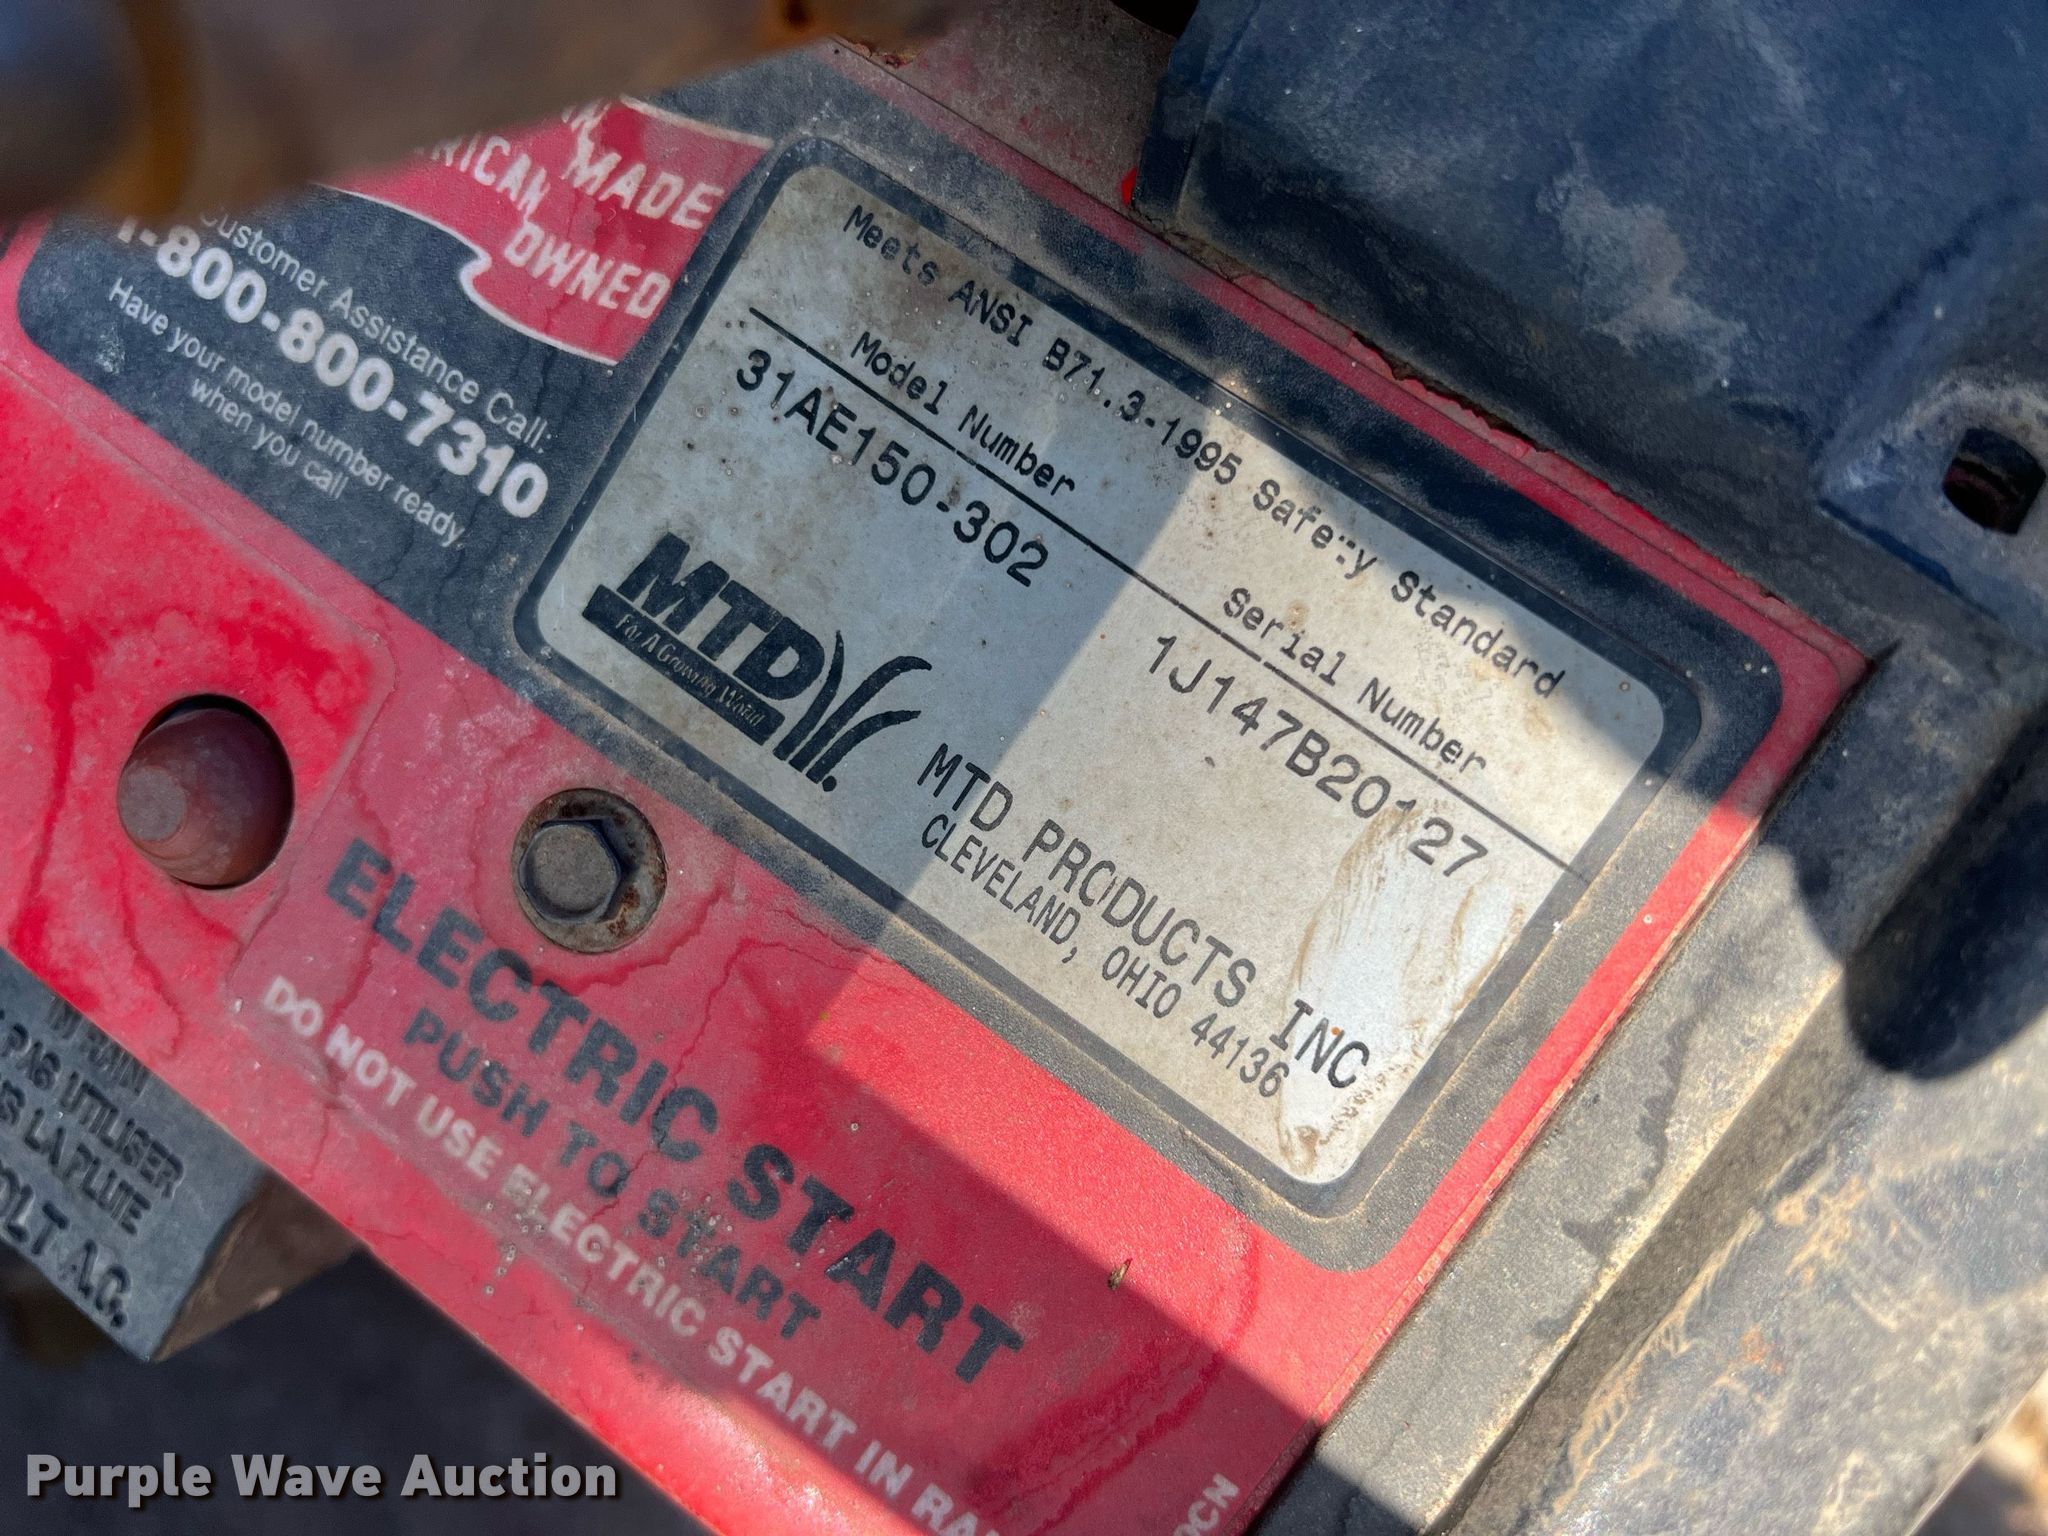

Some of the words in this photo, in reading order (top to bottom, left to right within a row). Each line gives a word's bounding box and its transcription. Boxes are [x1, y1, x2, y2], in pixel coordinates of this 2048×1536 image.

[504, 220, 671, 319] OWNED
[561, 148, 723, 230] MADE
[108, 277, 169, 336] Have
[166, 327, 225, 373] your
[225, 364, 300, 426] model
[300, 419, 393, 492] number
[393, 484, 465, 547] ready
[190, 378, 252, 433] when
[252, 423, 300, 468] you
[303, 460, 349, 500] call
[329, 287, 480, 404] Assistance
[486, 392, 552, 453] Call:
[736, 348, 1048, 588] 31AE150-302
[843, 205, 939, 286] Meets
[949, 280, 1033, 347] ANSI
[1042, 337, 1242, 485] B71.3-1995
[1390, 570, 1566, 699] Standard
[850, 332, 947, 415] Model
[958, 405, 1075, 496] Number
[615, 532, 826, 702] MTD
[641, 633, 662, 653] A
[1223, 587, 1349, 686] Serial
[1357, 677, 1488, 776] Number
[1147, 635, 1490, 879] 1J147B20127
[916, 743, 1014, 832] MTD
[1023, 818, 1256, 1008] PRODUCTS
[1269, 999, 1370, 1089] INC
[921, 815, 1081, 964] CLEVELAND,
[1101, 946, 1182, 1019] OHIO
[1191, 1013, 1290, 1098] 44136
[326, 838, 719, 1163] ELECTRIC
[726, 1143, 1025, 1384] START
[404, 1007, 549, 1140] PUSH
[559, 1119, 634, 1200] TO
[636, 1186, 822, 1341] START
[262, 975, 325, 1038] DO
[323, 1022, 416, 1109] NOT
[415, 1093, 502, 1182] USE
[506, 1162, 707, 1340] ELECTRIC
[706, 1326, 857, 1448] START
[854, 1440, 914, 1498] IN
[911, 1482, 1000, 1536] RA
